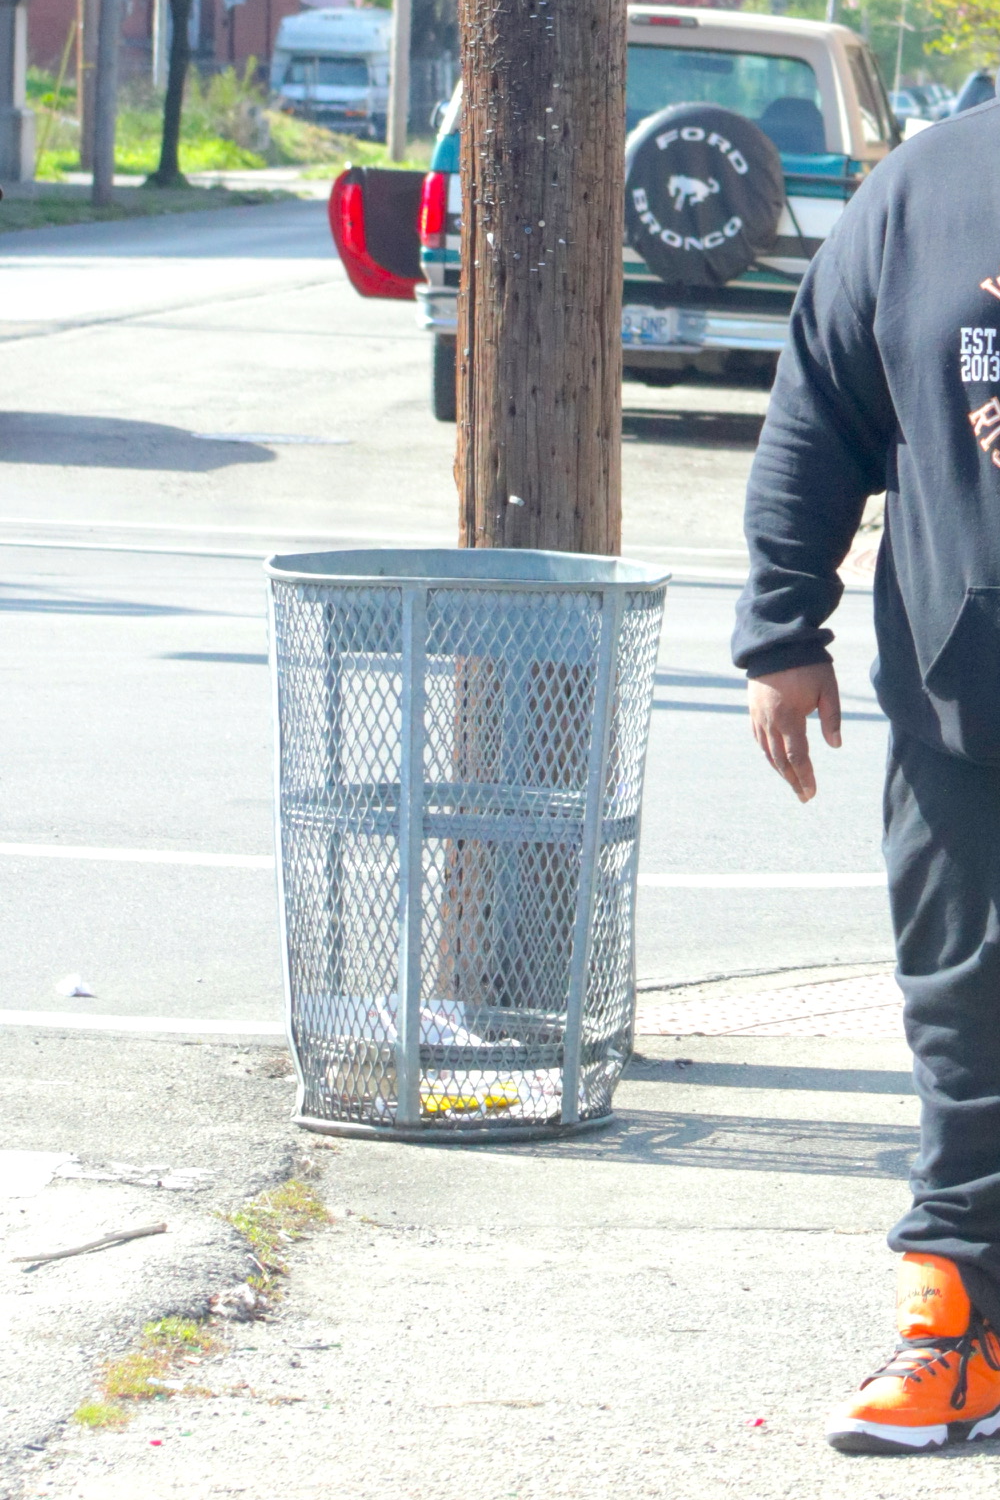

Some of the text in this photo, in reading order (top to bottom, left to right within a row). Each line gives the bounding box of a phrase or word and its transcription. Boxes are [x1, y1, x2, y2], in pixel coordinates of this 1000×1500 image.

[655, 126, 749, 175] FORD
[632, 187, 743, 251] BRONCO
[960, 327, 1000, 356] EST.
[960, 356, 1000, 382] 2013
